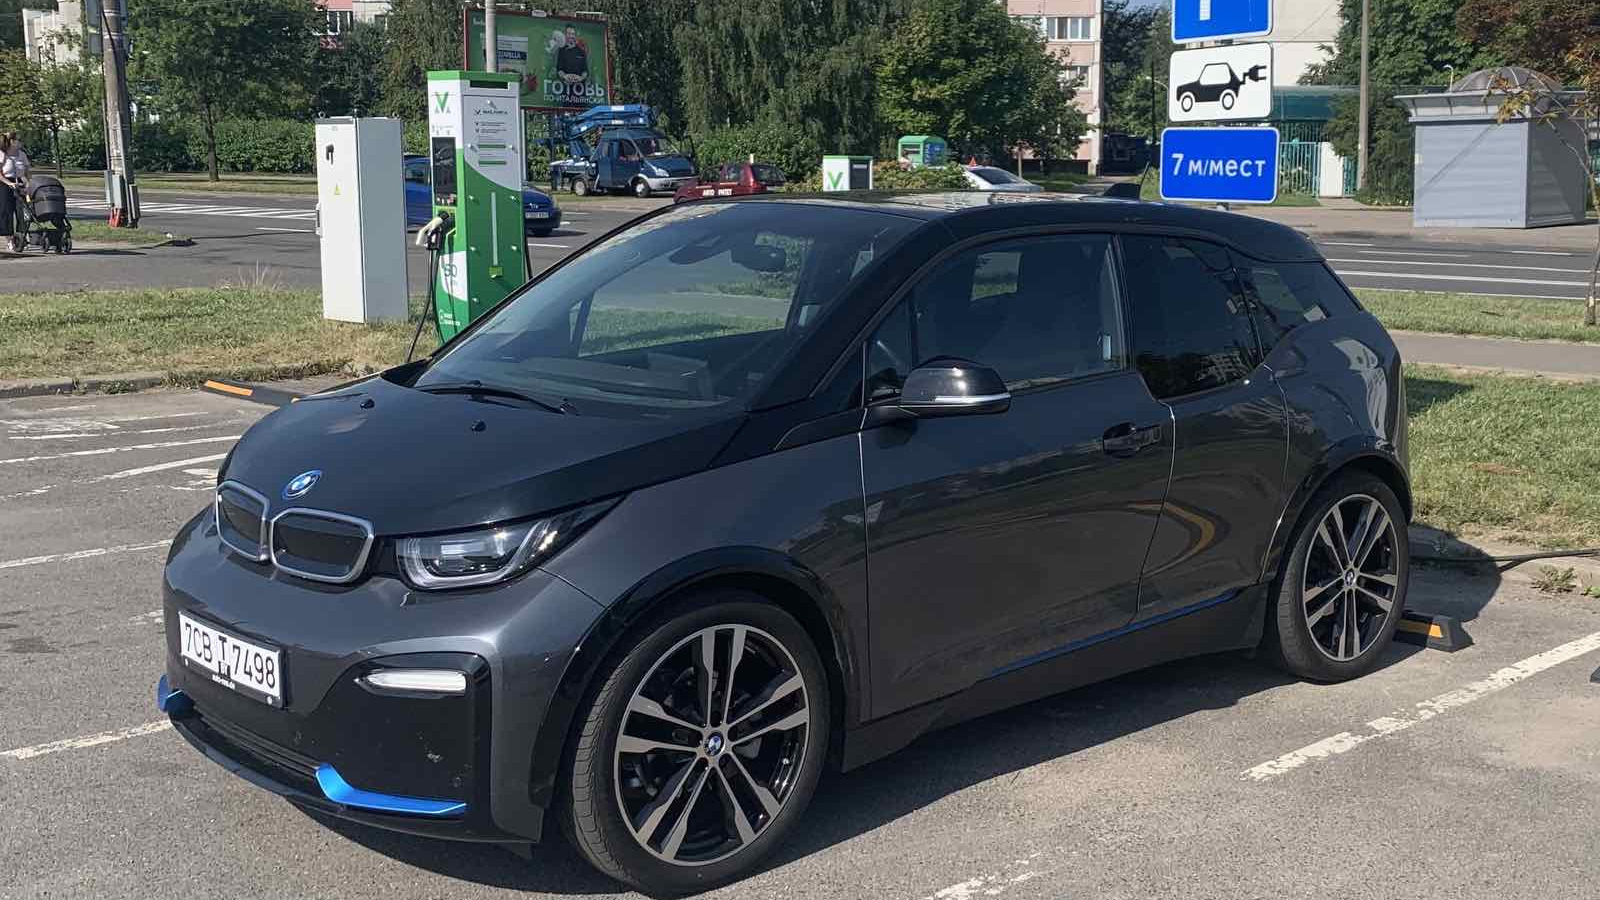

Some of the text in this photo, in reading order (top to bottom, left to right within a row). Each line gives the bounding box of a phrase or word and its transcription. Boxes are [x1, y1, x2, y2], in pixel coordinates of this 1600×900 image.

[543, 79, 605, 97] ГОТОВЬ
[1171, 153, 1185, 176] 7
[185, 622, 213, 663] 7CB
[218, 635, 228, 661] T
[232, 644, 276, 689] 7498
